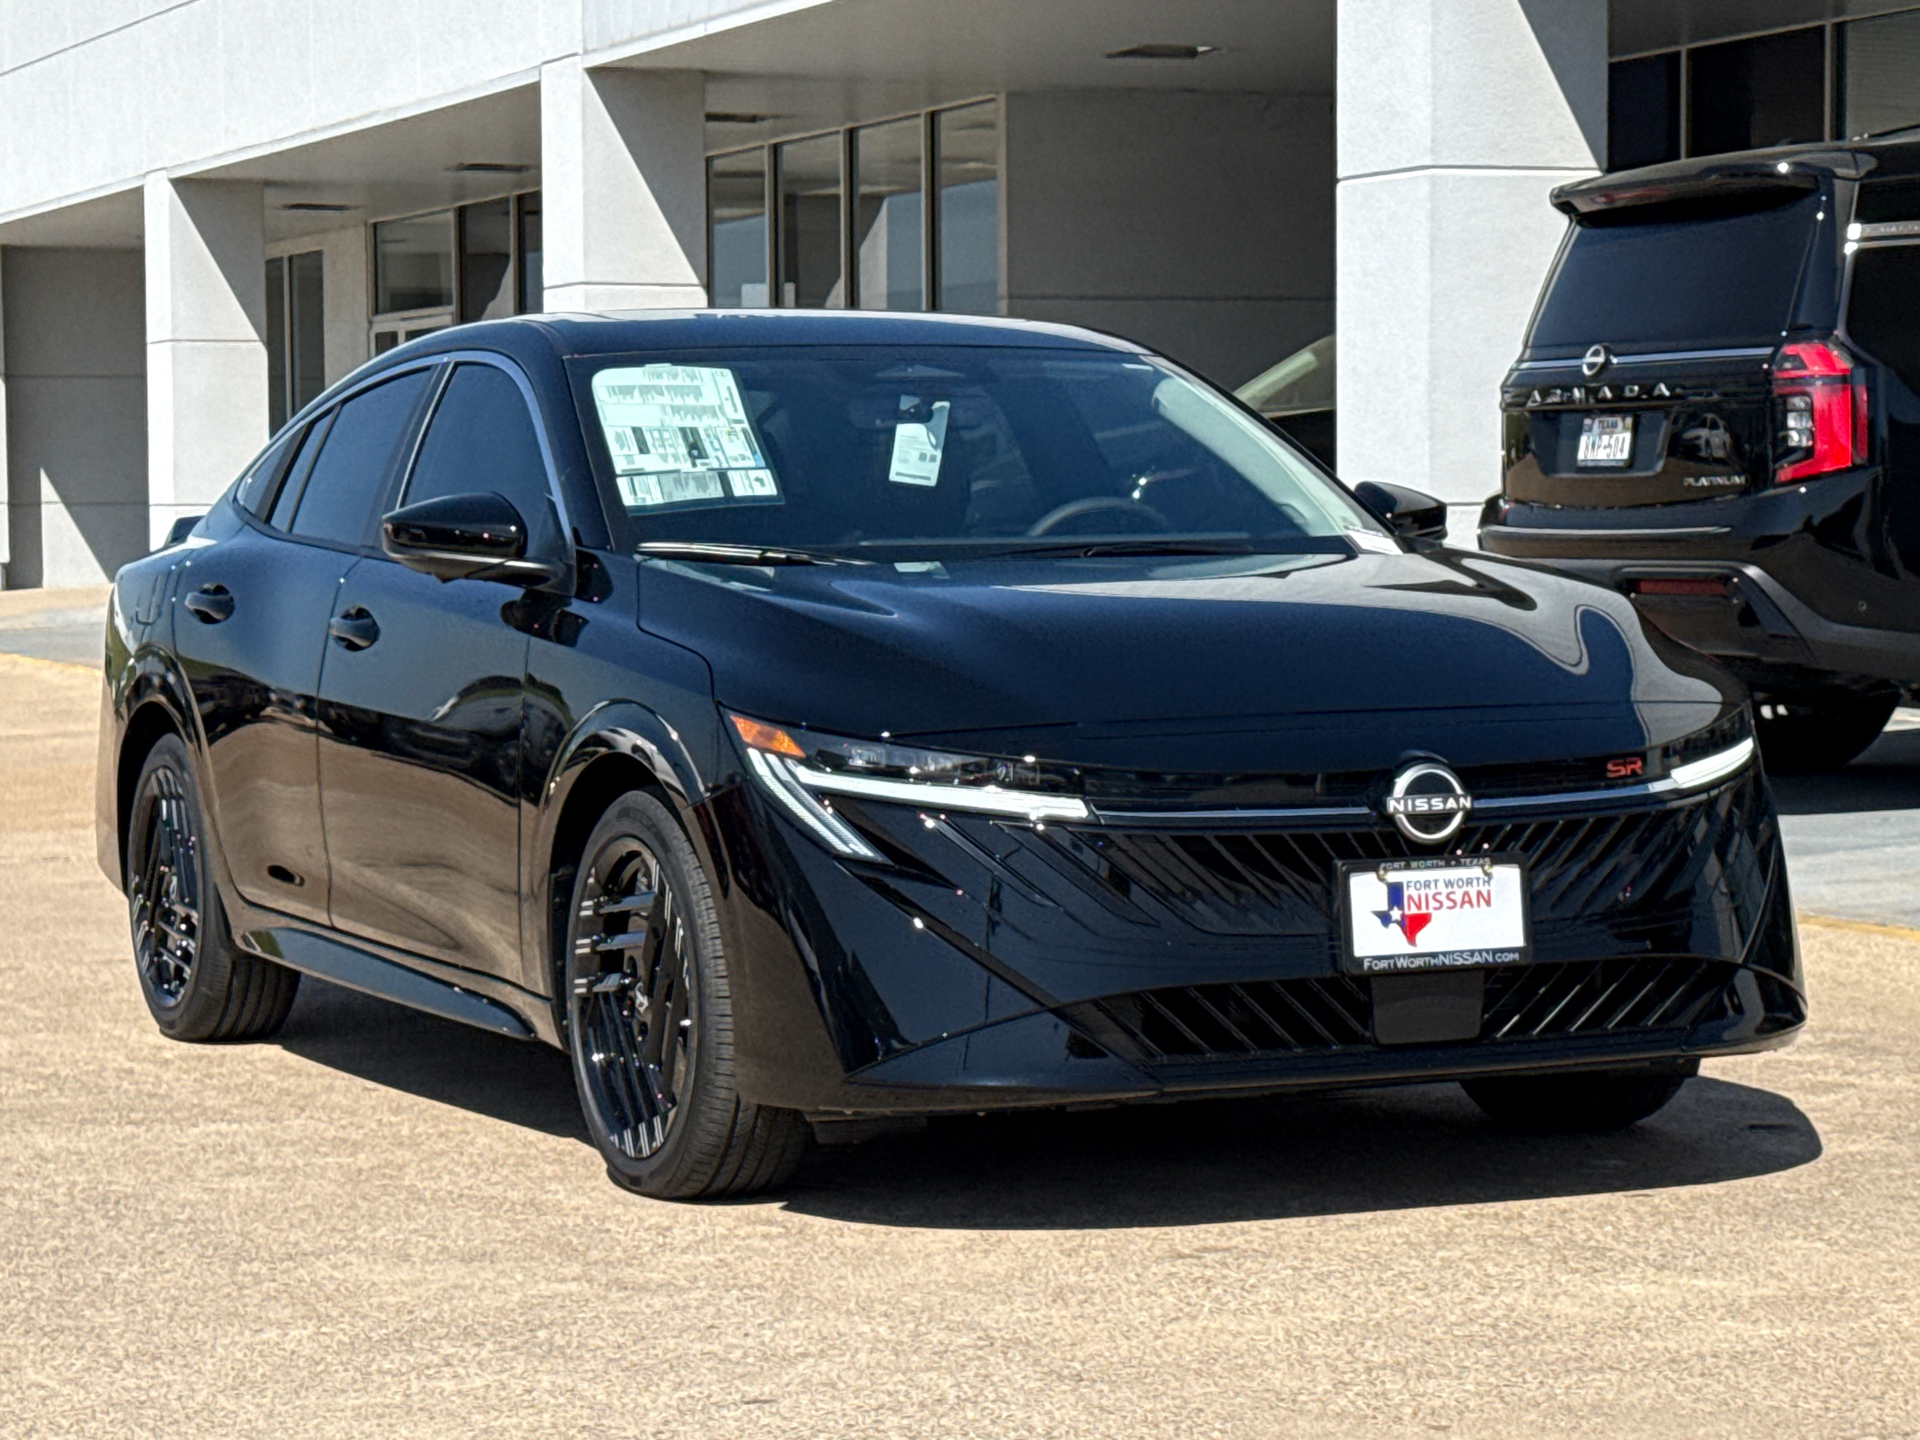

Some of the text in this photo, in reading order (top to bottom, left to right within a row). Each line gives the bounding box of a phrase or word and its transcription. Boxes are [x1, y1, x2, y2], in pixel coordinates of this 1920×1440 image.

[1682, 474, 1746, 488] PLATINUM
[1605, 757, 1644, 778] SR
[1387, 796, 1472, 813] NISSAN
[1379, 856, 1491, 871] FORT WORTH TEXAS
[1406, 876, 1491, 892] FORT WORTH
[1406, 889, 1492, 912] NISSAN
